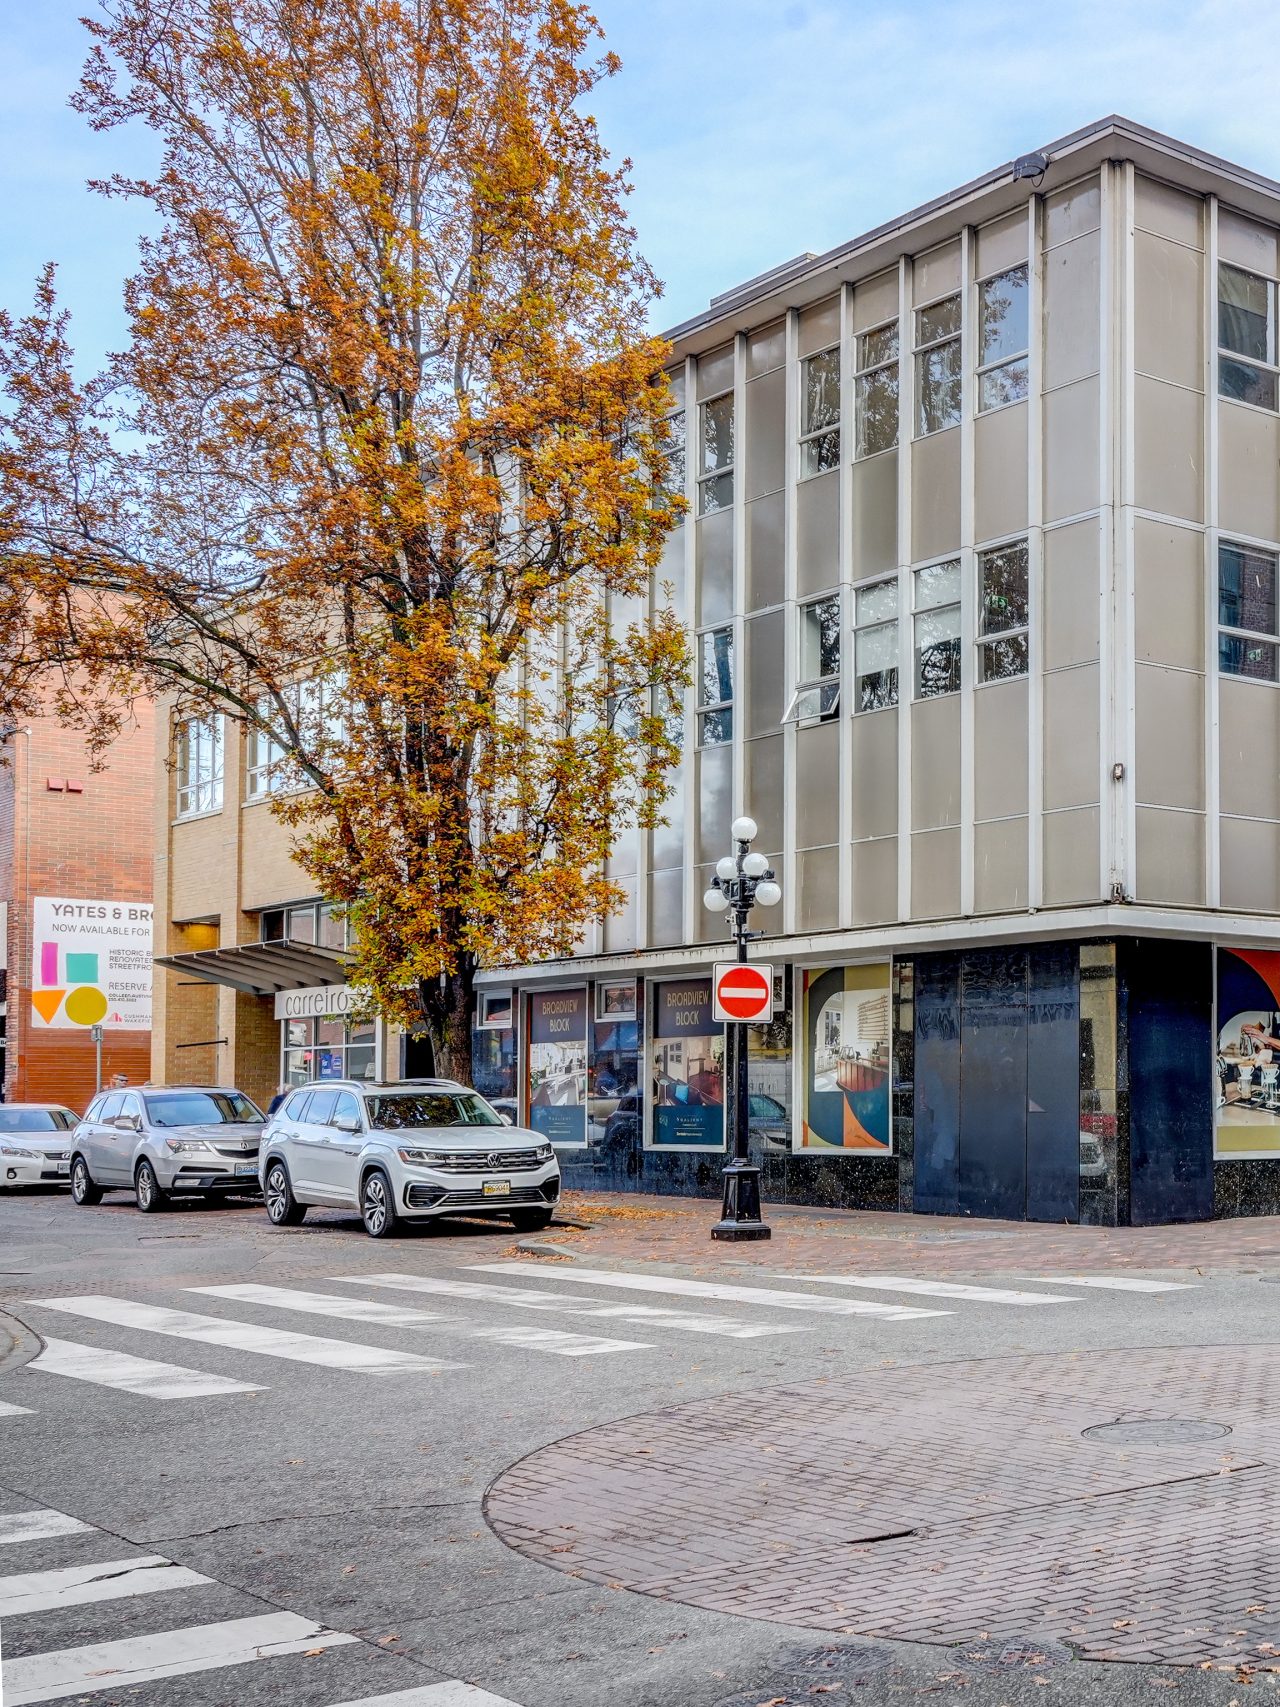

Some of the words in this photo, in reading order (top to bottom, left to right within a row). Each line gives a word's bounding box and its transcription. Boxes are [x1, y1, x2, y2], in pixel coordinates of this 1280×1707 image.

[52, 904, 106, 918] YATES
[112, 908, 122, 920] &
[52, 924, 78, 932] NOW
[80, 926, 128, 936] AVAILABLE
[131, 928, 150, 936] FOR
[108, 982, 148, 991] RESERVE
[286, 988, 348, 1016] carreiro
[542, 999, 578, 1015] BROADVIEW
[667, 990, 710, 1008] BROADVIEW
[550, 1018, 570, 1032] BLOCK
[676, 1010, 700, 1026] BLOCK
